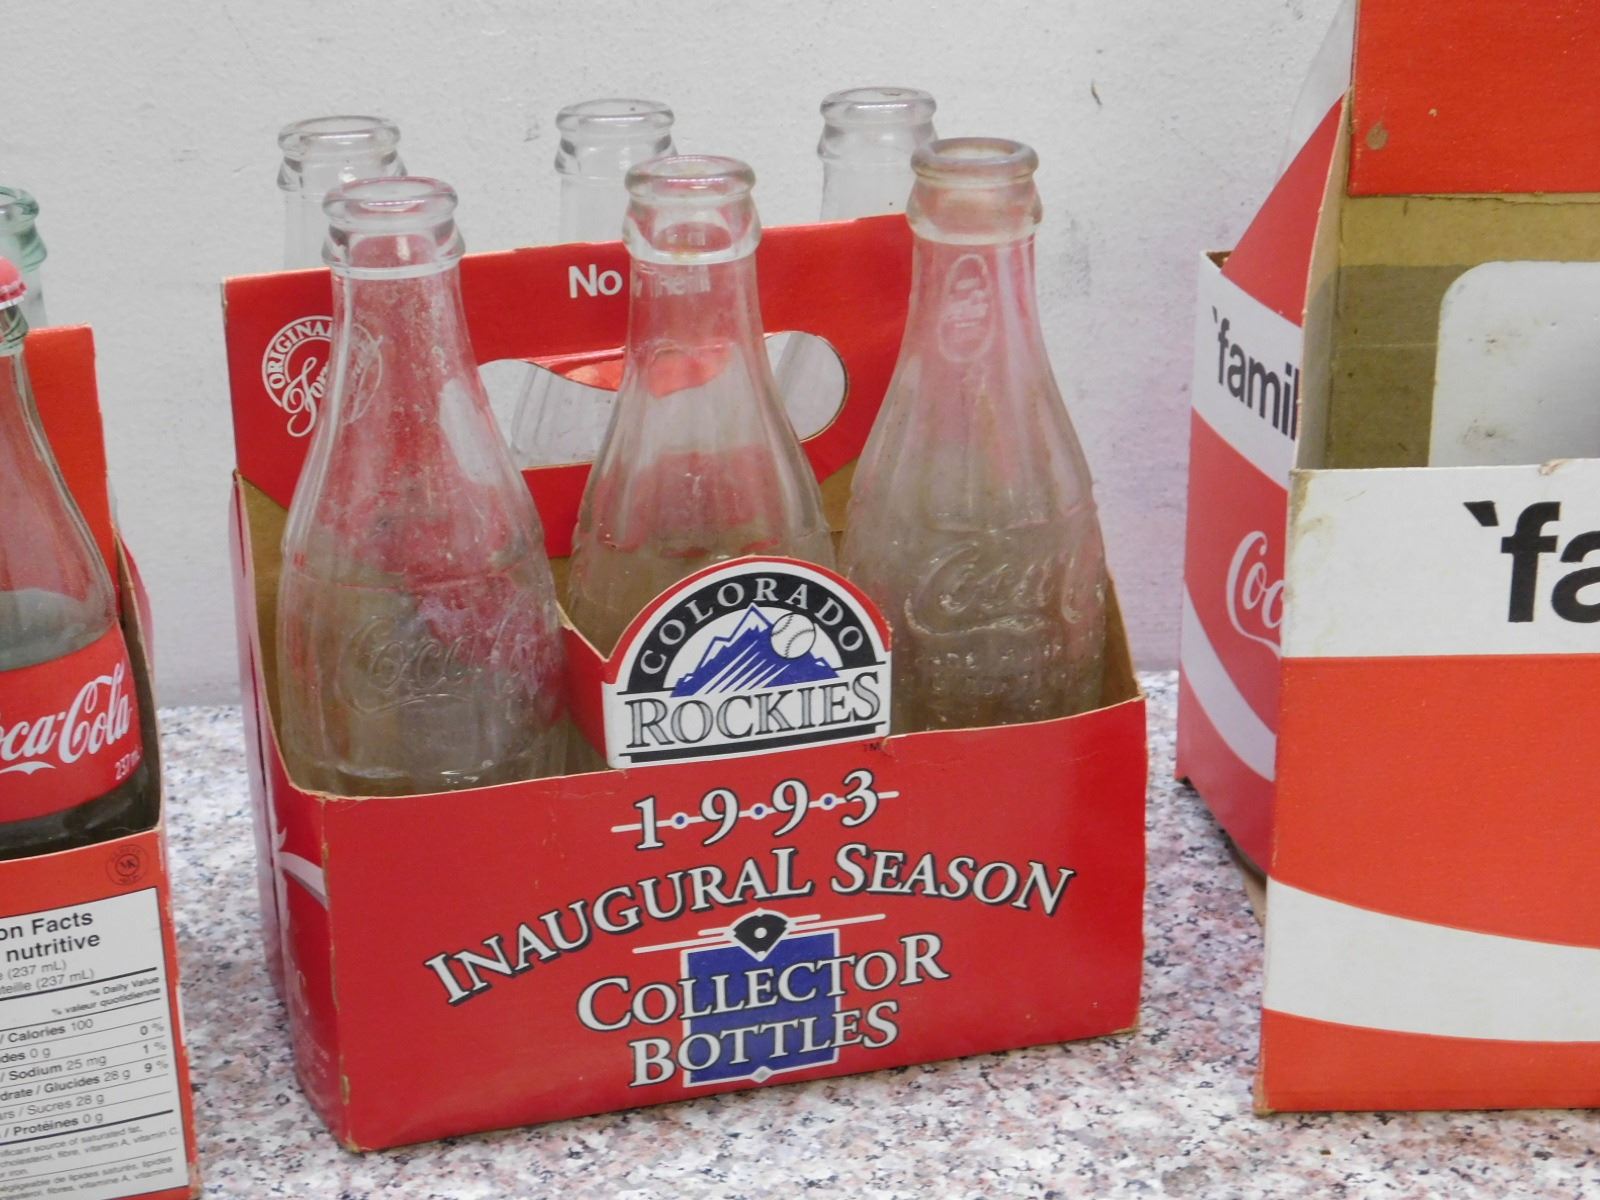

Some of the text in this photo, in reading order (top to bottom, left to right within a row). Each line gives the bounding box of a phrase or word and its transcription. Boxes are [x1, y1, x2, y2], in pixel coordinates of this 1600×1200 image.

[567, 263, 623, 298] No
[640, 577, 864, 675] COLORADO
[624, 671, 881, 749] ROCKIES
[32, 912, 94, 935] Facts
[424, 841, 1076, 1006] INAUGURAL SEASON
[6, 933, 101, 962] nutritive
[7, 963, 37, 981] (237
[36, 973, 65, 990] (237
[577, 932, 949, 1032] COLLECTOR
[8, 1026, 67, 1043] Calories
[71, 1018, 95, 1031] 100
[29, 1047, 39, 1058] 0
[140, 1025, 149, 1036] 0
[629, 1000, 900, 1088] BOTTLES
[9, 1063, 63, 1081] Sodium
[66, 1058, 82, 1071] 25
[86, 1055, 107, 1067] mg
[142, 1044, 149, 1055] 1
[44, 1076, 100, 1093] Glucides
[103, 1070, 120, 1083] 28
[144, 1062, 153, 1073] 9
[27, 1099, 73, 1116] Sucres
[75, 1094, 92, 1107] 28
[13, 1117, 79, 1136] Protéines
[82, 1113, 91, 1124] 0
